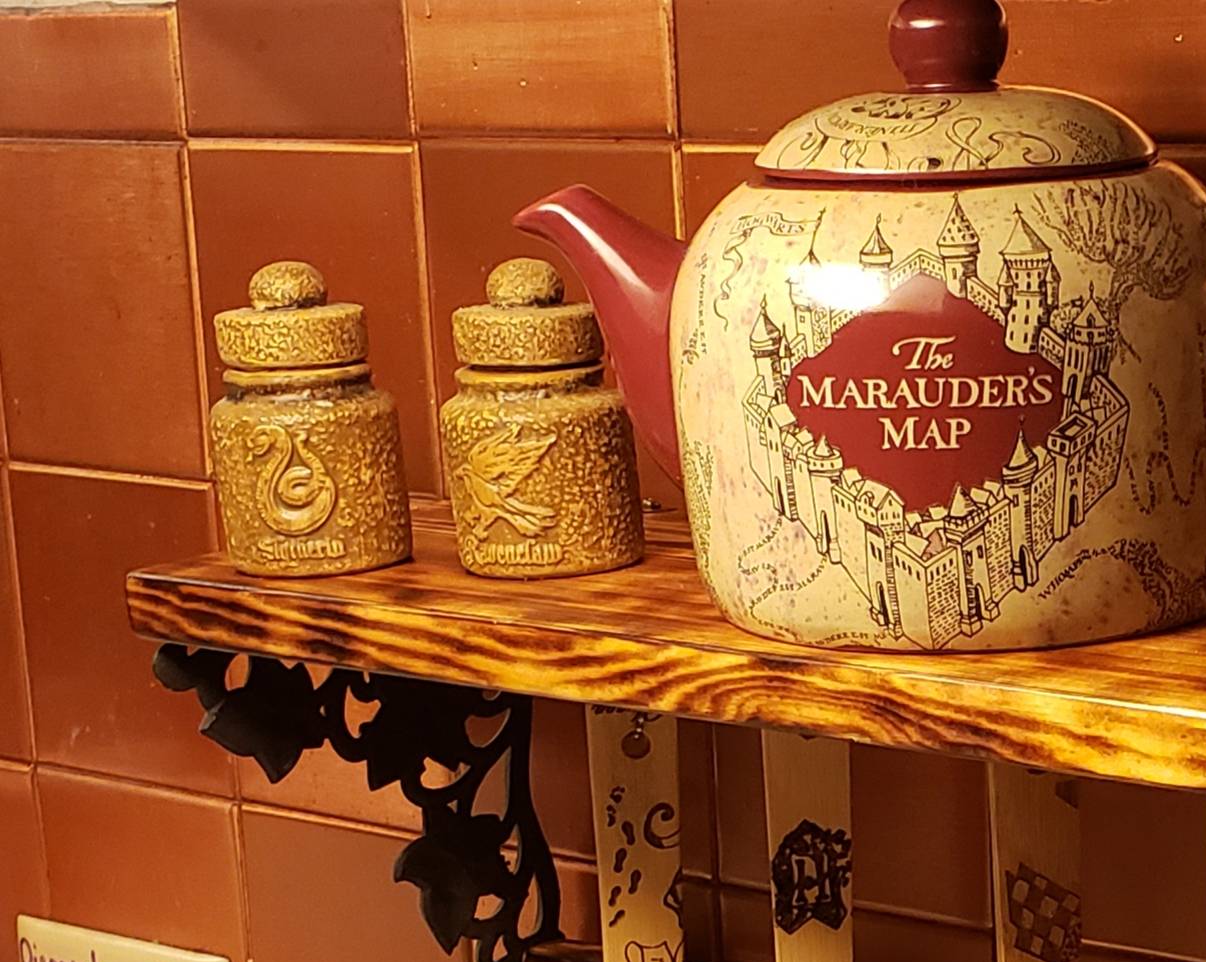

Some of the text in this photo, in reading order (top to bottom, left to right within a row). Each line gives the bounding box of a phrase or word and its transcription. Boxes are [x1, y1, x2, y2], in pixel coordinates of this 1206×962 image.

[892, 335, 956, 371] The
[796, 366, 1053, 410] MARAUDER'S
[878, 416, 972, 450] MAP
